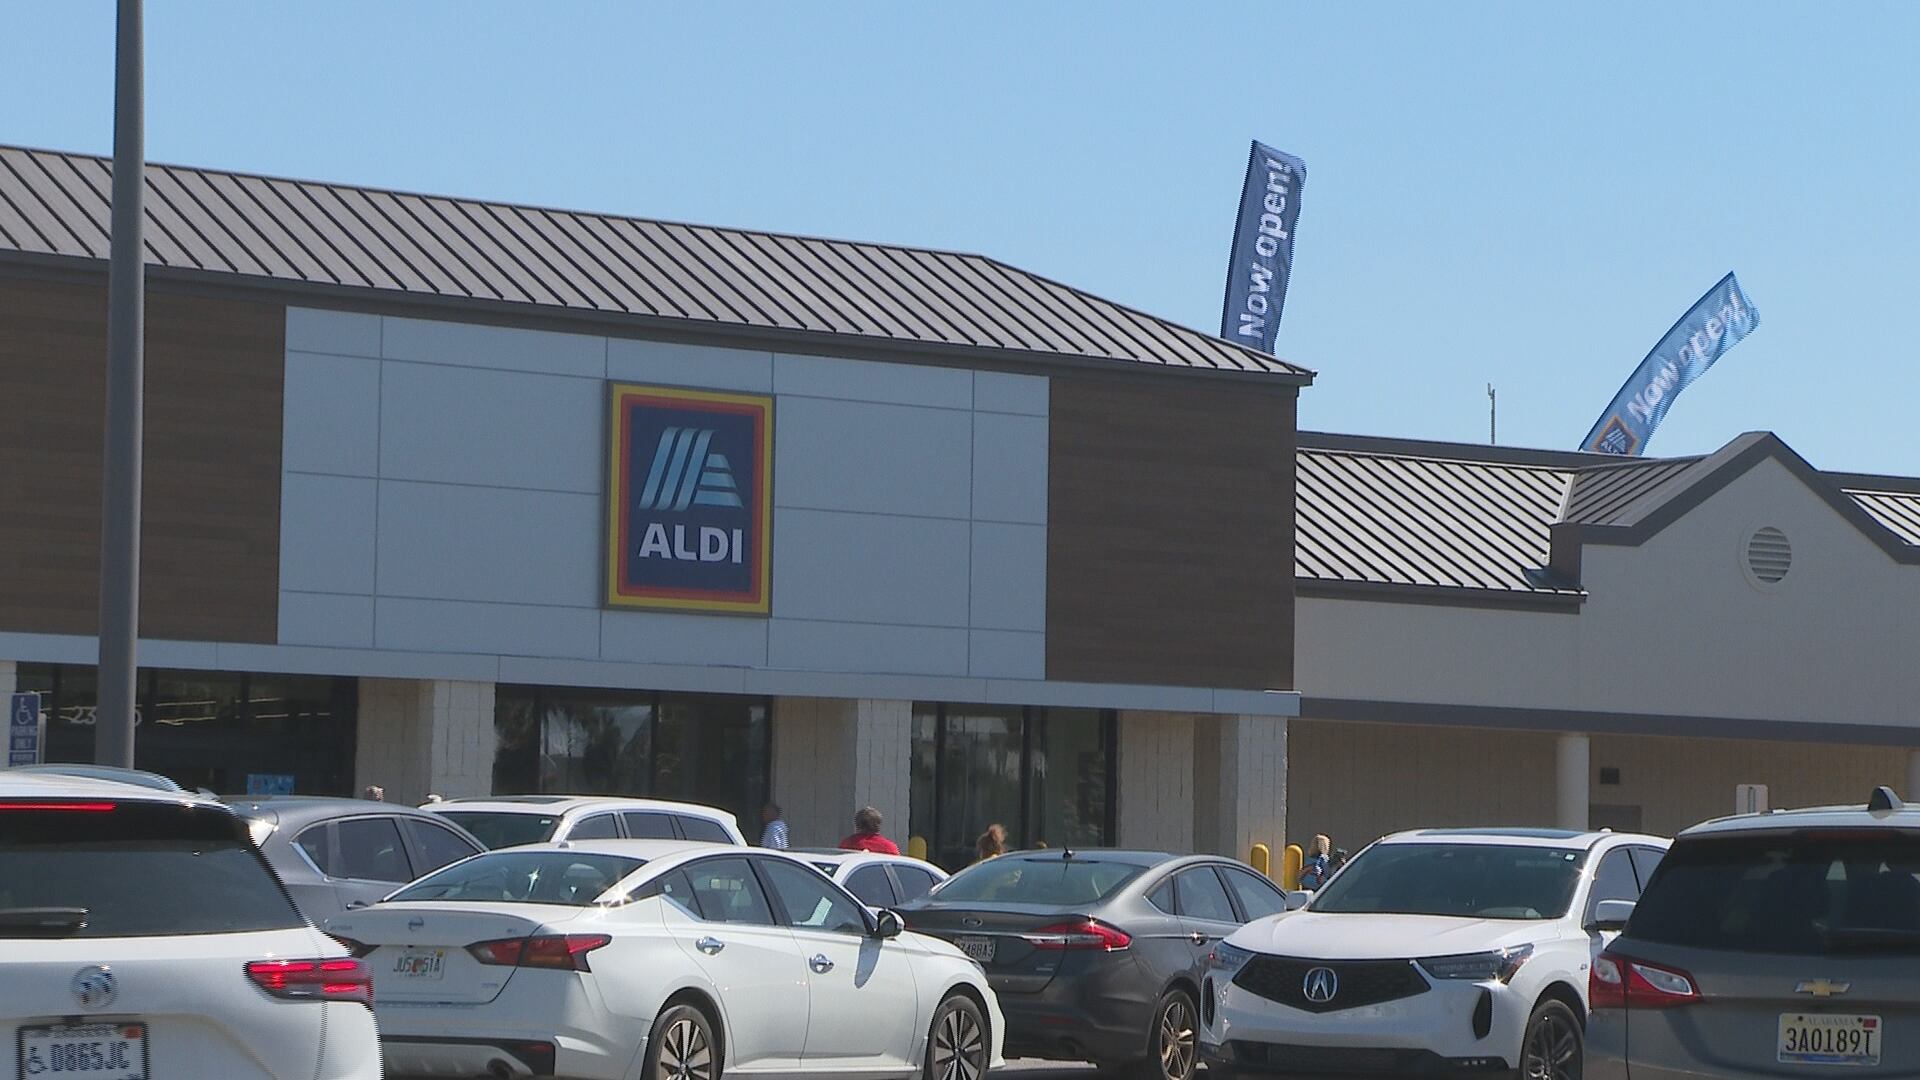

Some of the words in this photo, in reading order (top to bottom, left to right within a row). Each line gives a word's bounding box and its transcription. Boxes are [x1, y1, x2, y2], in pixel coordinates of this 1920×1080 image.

[1255, 157, 1293, 258] open!
[1238, 262, 1273, 339] Now
[1627, 360, 1681, 424] Now
[639, 523, 743, 564] ALDI
[51, 1041, 130, 1072] D865JC
[1786, 1027, 1874, 1056] 3A0189T
